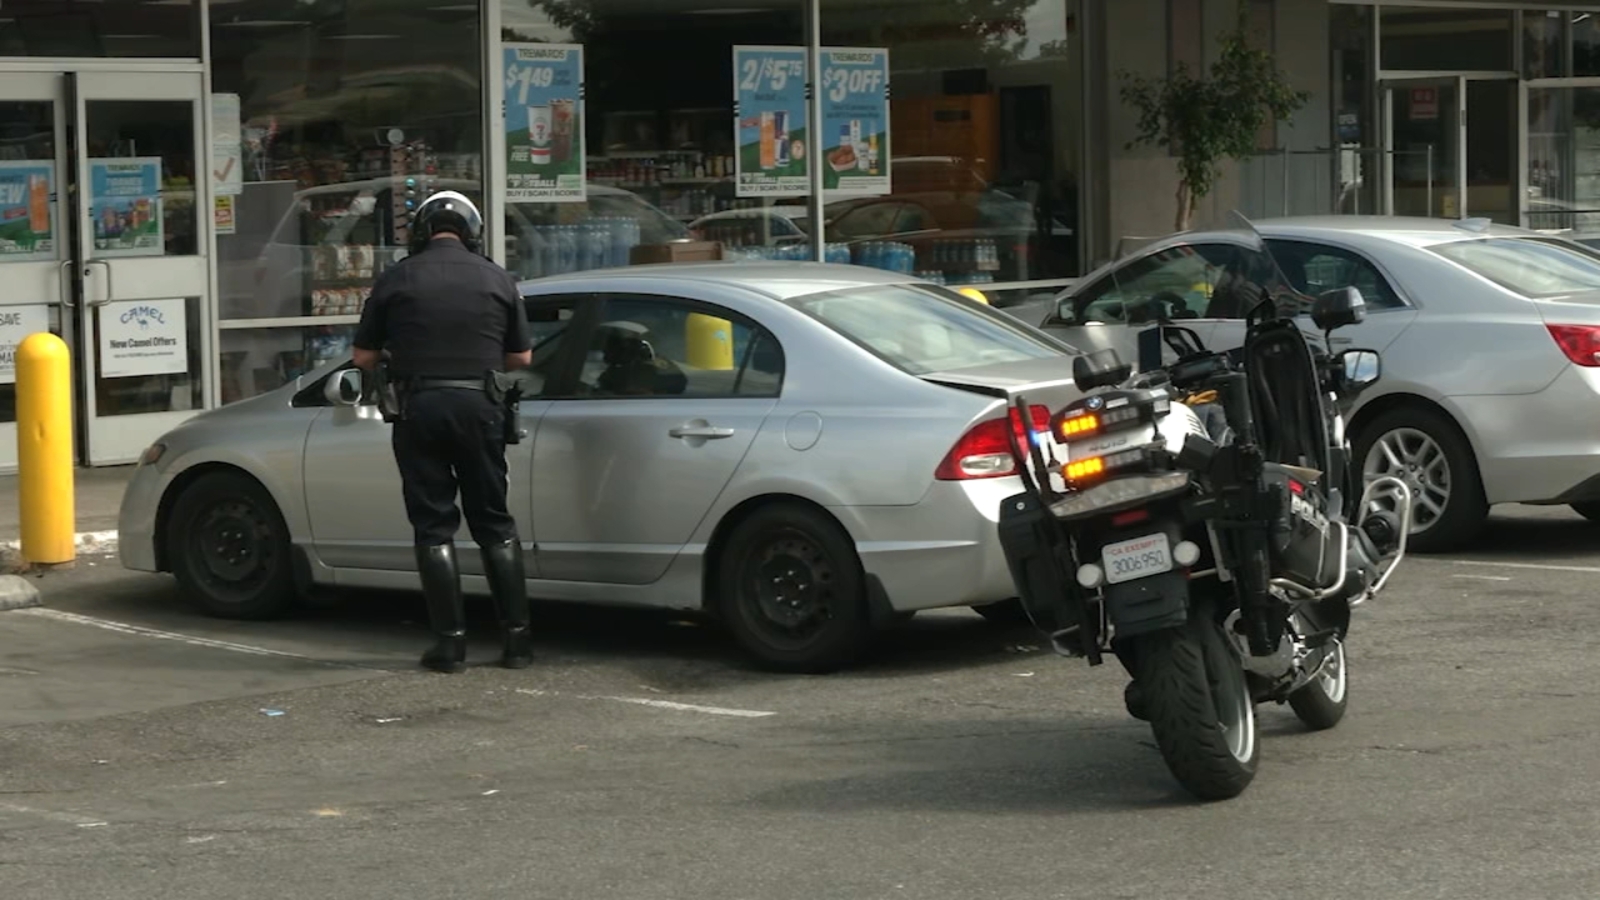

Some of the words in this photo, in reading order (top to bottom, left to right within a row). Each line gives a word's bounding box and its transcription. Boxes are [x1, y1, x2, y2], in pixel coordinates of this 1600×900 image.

[849, 69, 882, 93] OFF
[120, 306, 165, 324] CAMEL
[128, 337, 152, 348] Camel
[153, 336, 177, 347] Offers
[1125, 540, 1157, 552] EXEMPT
[1112, 550, 1164, 575] 3006950
